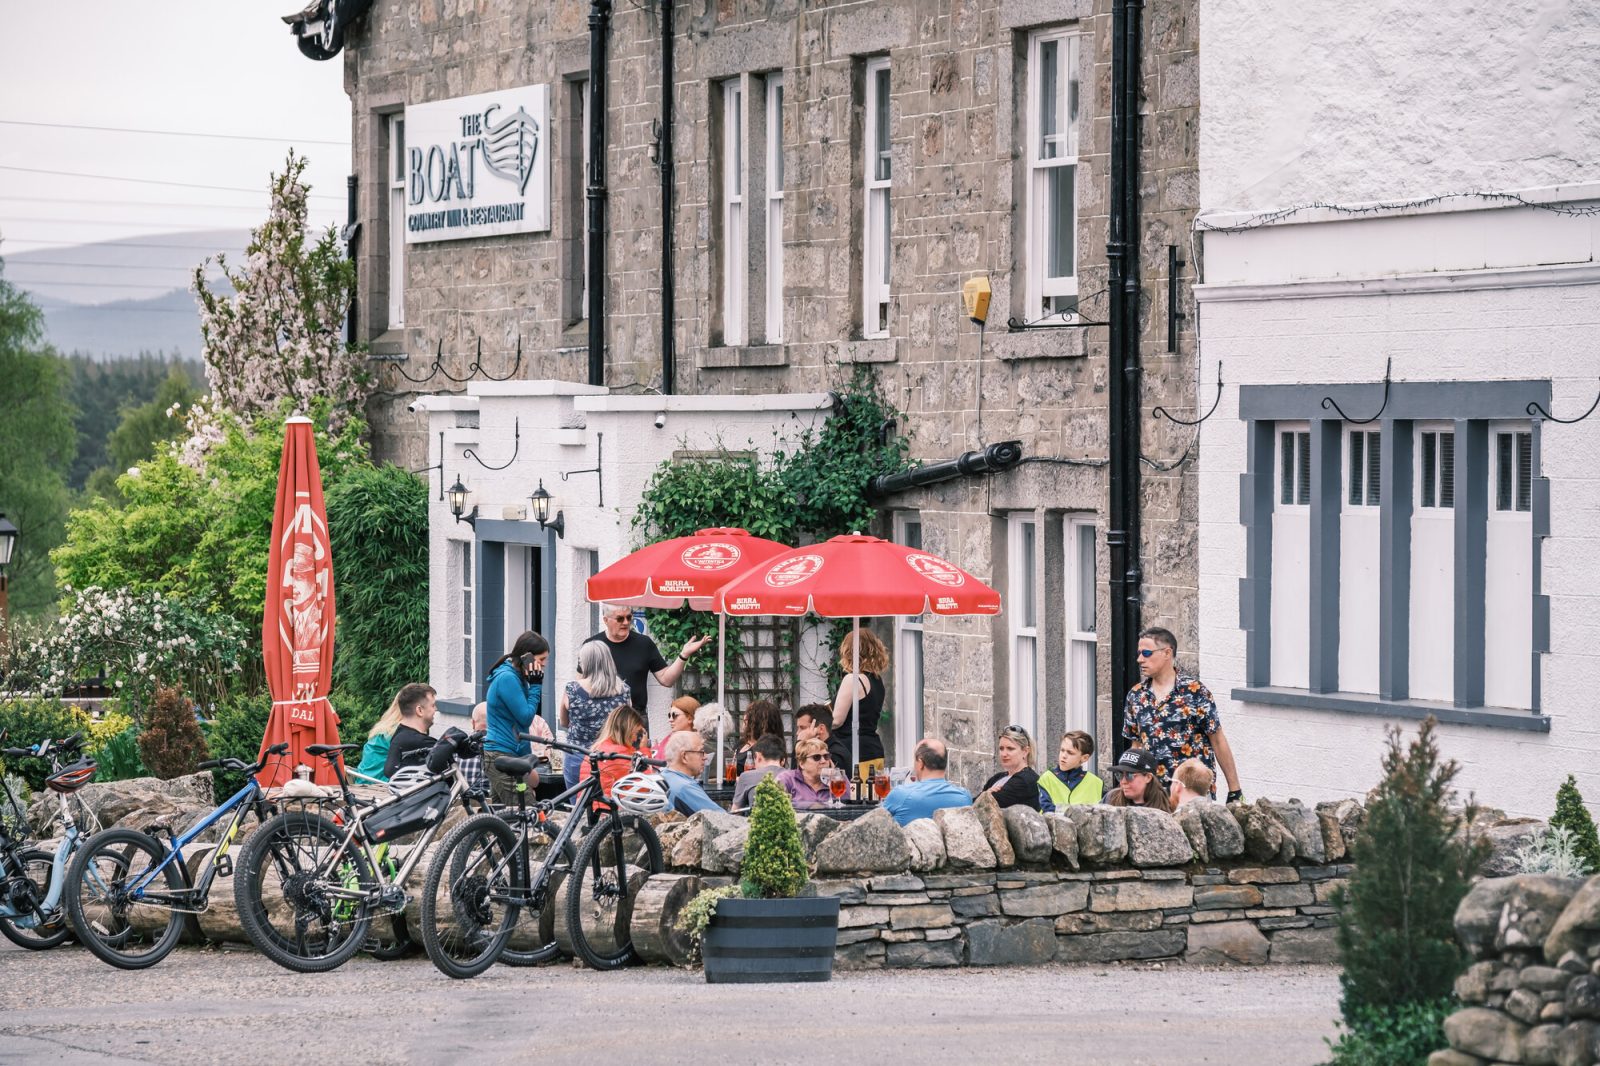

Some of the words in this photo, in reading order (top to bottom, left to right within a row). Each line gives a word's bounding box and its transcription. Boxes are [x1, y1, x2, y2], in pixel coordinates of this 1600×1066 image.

[459, 112, 483, 137] THE
[407, 138, 481, 206] BOAT
[408, 210, 446, 232] COUNTRY
[446, 208, 462, 228] INN
[462, 207, 469, 227] &
[470, 202, 525, 225] RESTAURANT
[291, 707, 315, 722] DAL
